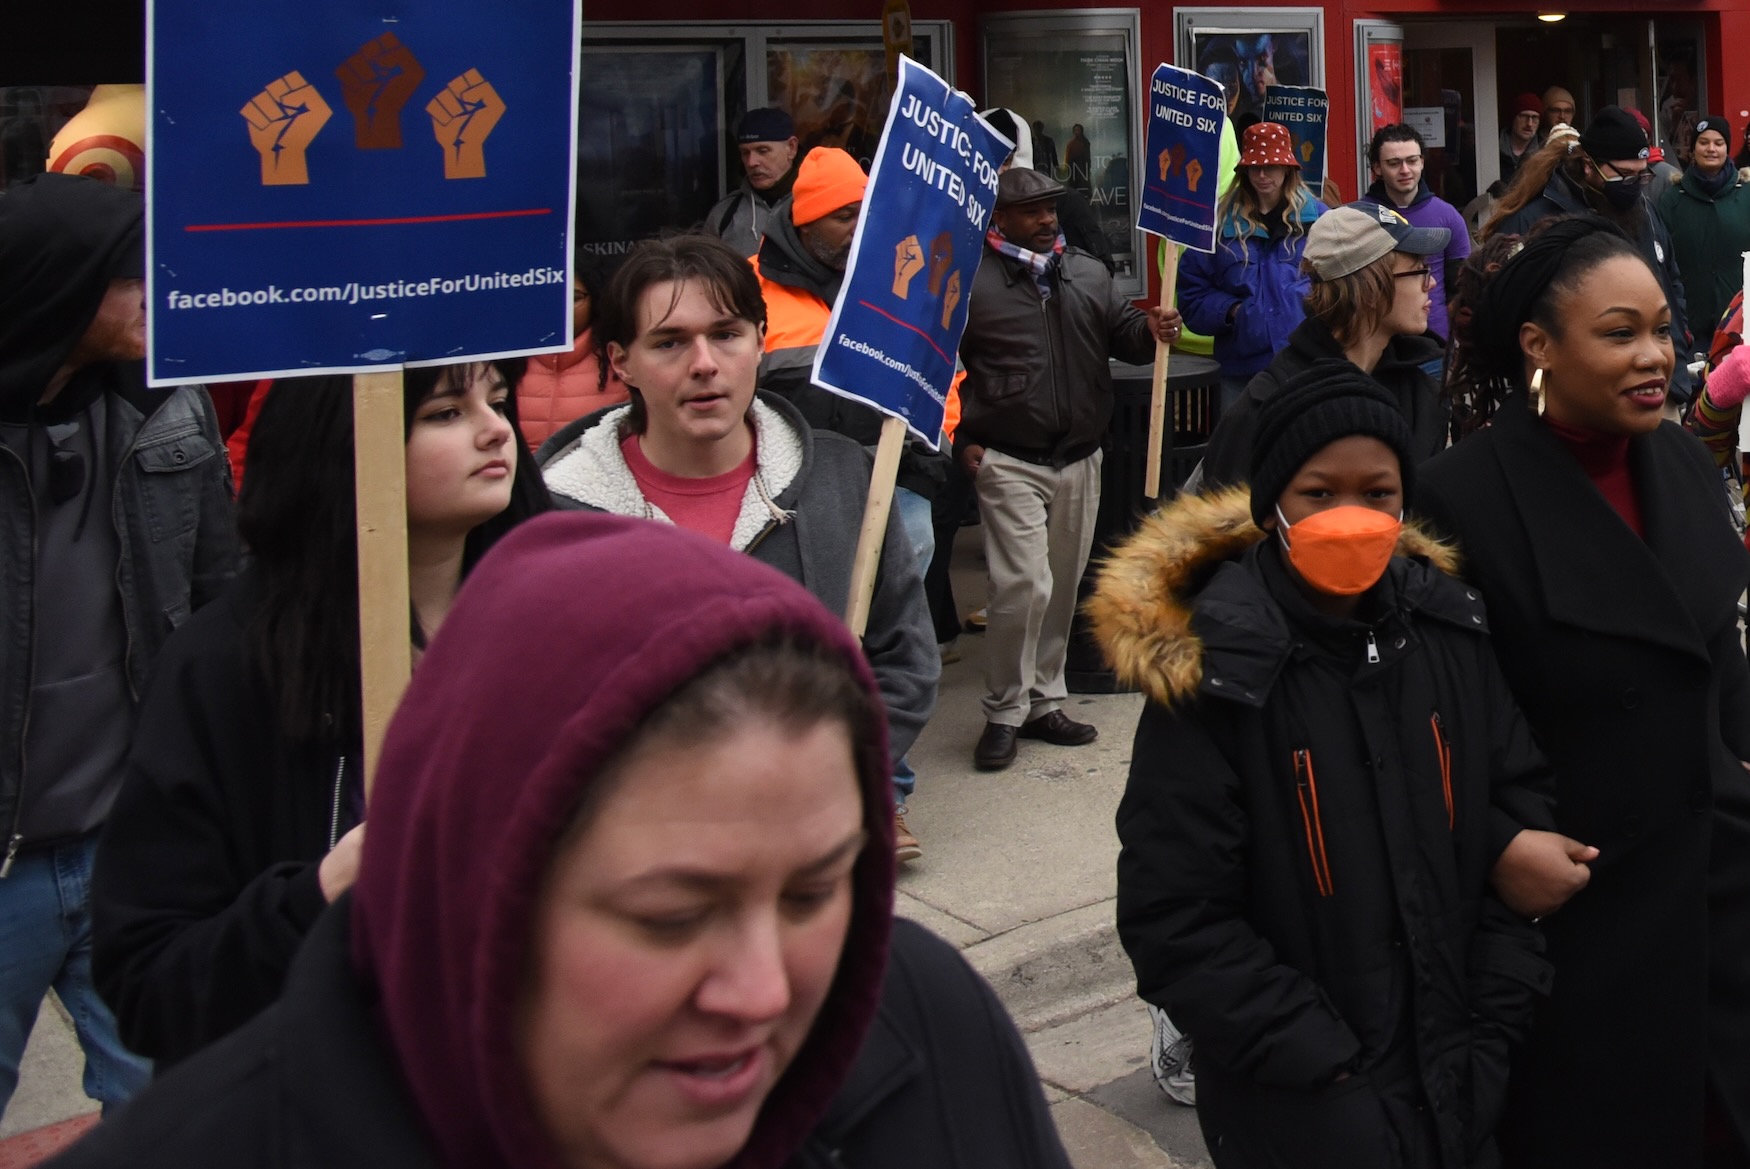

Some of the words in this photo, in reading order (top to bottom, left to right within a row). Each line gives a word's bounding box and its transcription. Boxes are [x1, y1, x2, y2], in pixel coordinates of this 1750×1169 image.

[1152, 79, 1197, 105] JUSTICE
[1199, 93, 1225, 112] FOR
[1266, 95, 1305, 107] JUSTICE
[1307, 98, 1329, 108] FOR
[1155, 103, 1193, 128] UNITED
[1196, 117, 1217, 135] SIX
[1268, 111, 1304, 122] UNITED
[1306, 112, 1323, 123] SIX
[973, 149, 999, 196] FOR
[967, 197, 987, 231] SIX
[167, 266, 565, 309] facebook.com/JusticeForUnitedSix
